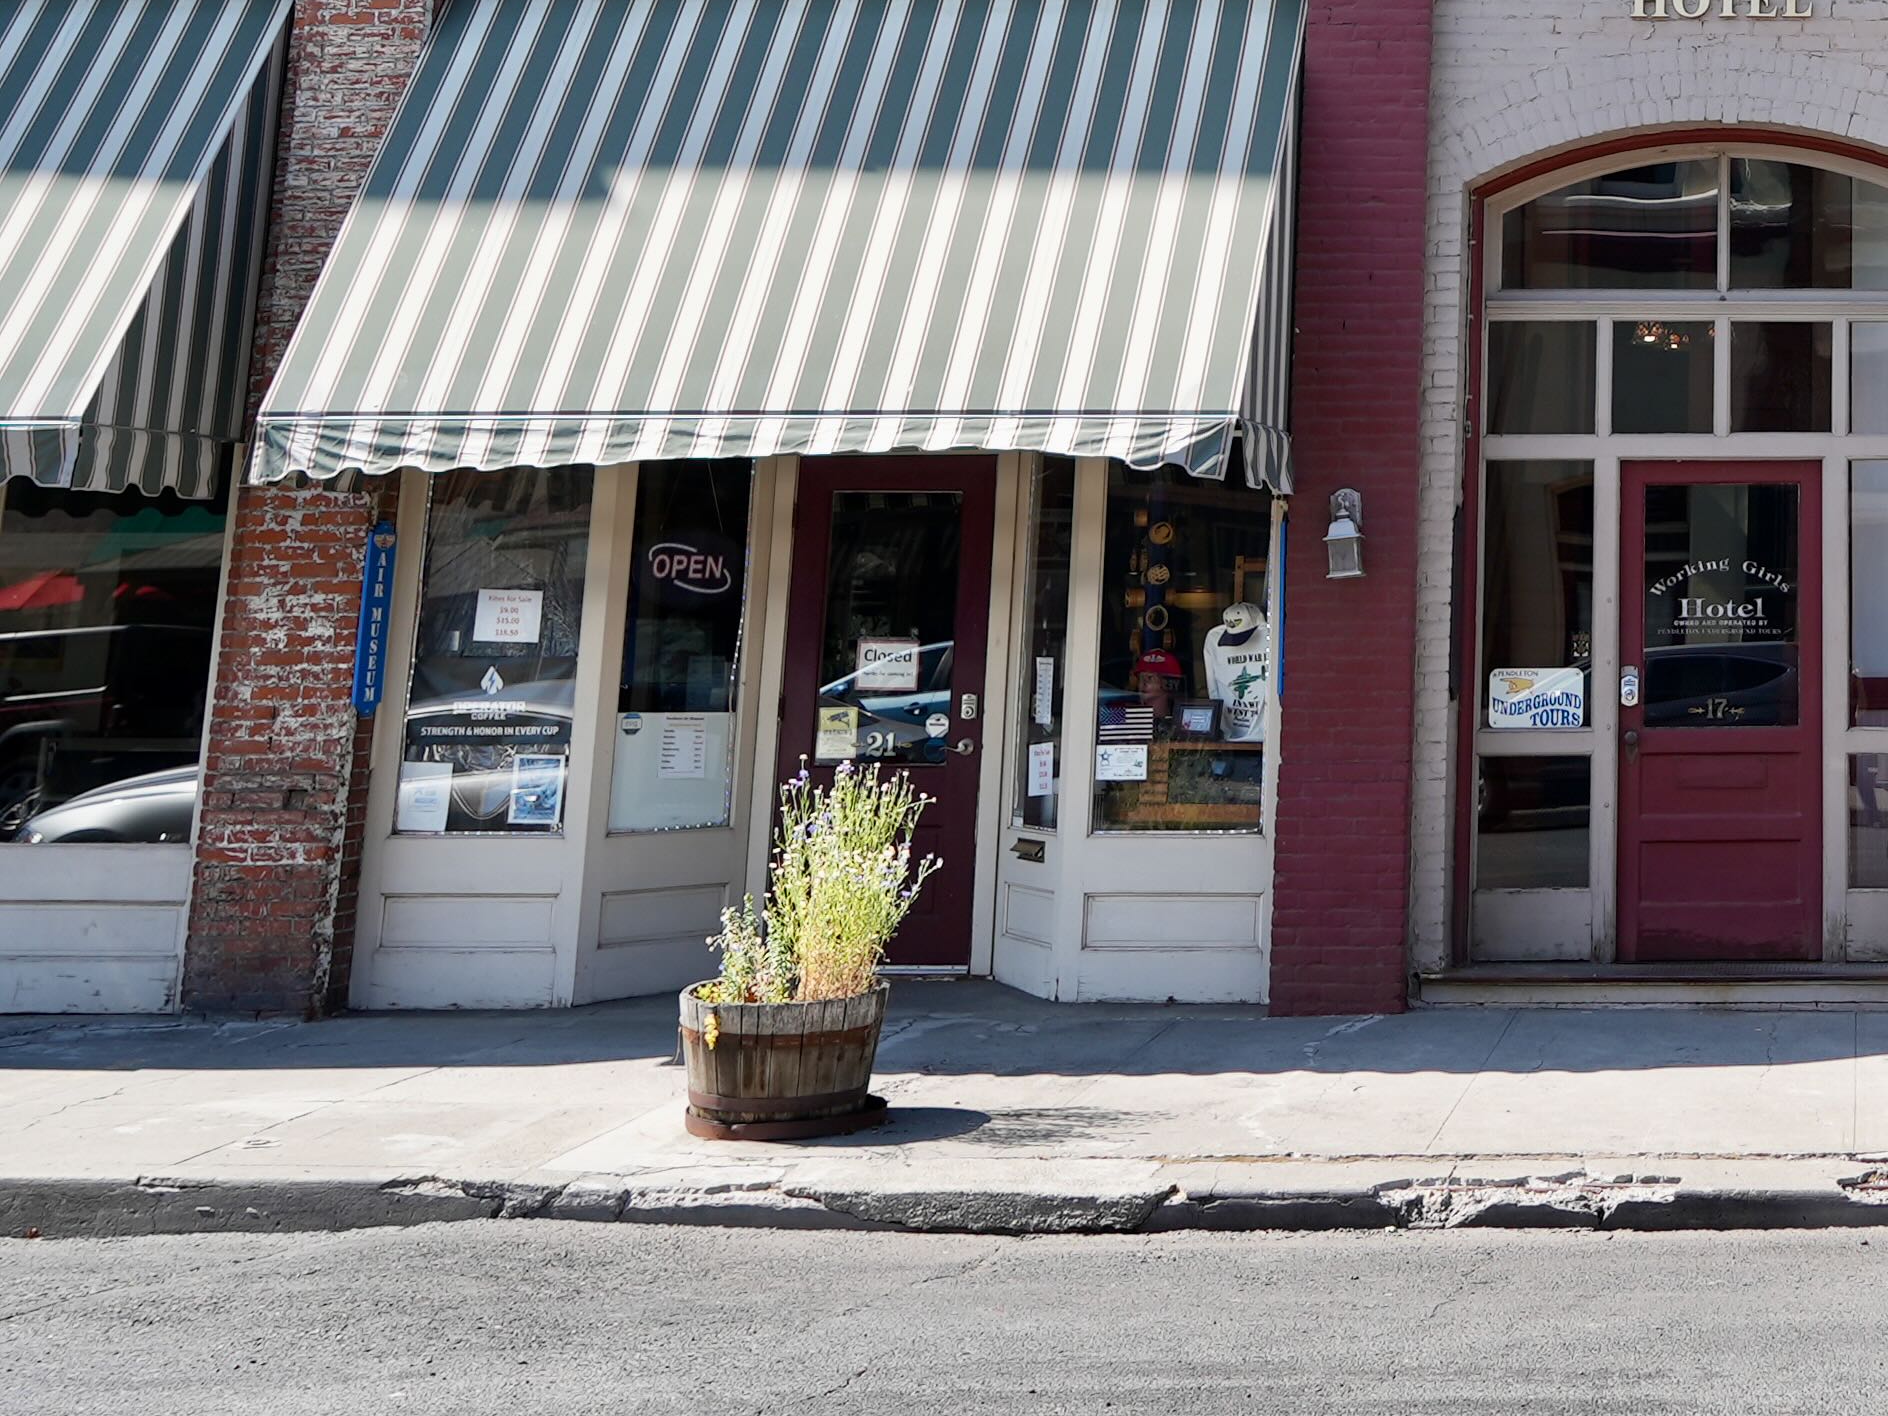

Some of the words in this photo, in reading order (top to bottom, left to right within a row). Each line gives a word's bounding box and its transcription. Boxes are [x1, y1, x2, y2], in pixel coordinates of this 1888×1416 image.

[374, 551, 387, 598] AIR
[653, 554, 723, 579] OPEN
[1649, 558, 1730, 596] Working
[1742, 560, 1790, 593] Girls
[1677, 597, 1765, 618] Hotel
[363, 607, 383, 703] MUSEUM
[864, 648, 912, 663] Closed
[1228, 654, 1247, 665] WORLD
[1248, 653, 1263, 663] WAR
[1492, 691, 1582, 716] UNDERGROUND
[1707, 698, 1728, 719] 17
[471, 712, 506, 721] COFFEE
[1530, 708, 1580, 727] TOURS
[421, 726, 465, 736] STRENGTH
[466, 727, 473, 736] &
[474, 727, 503, 736] HONOR
[504, 727, 514, 735] IN
[515, 726, 542, 735] EVERY
[542, 725, 559, 735] CUP
[866, 732, 896, 757] 21
